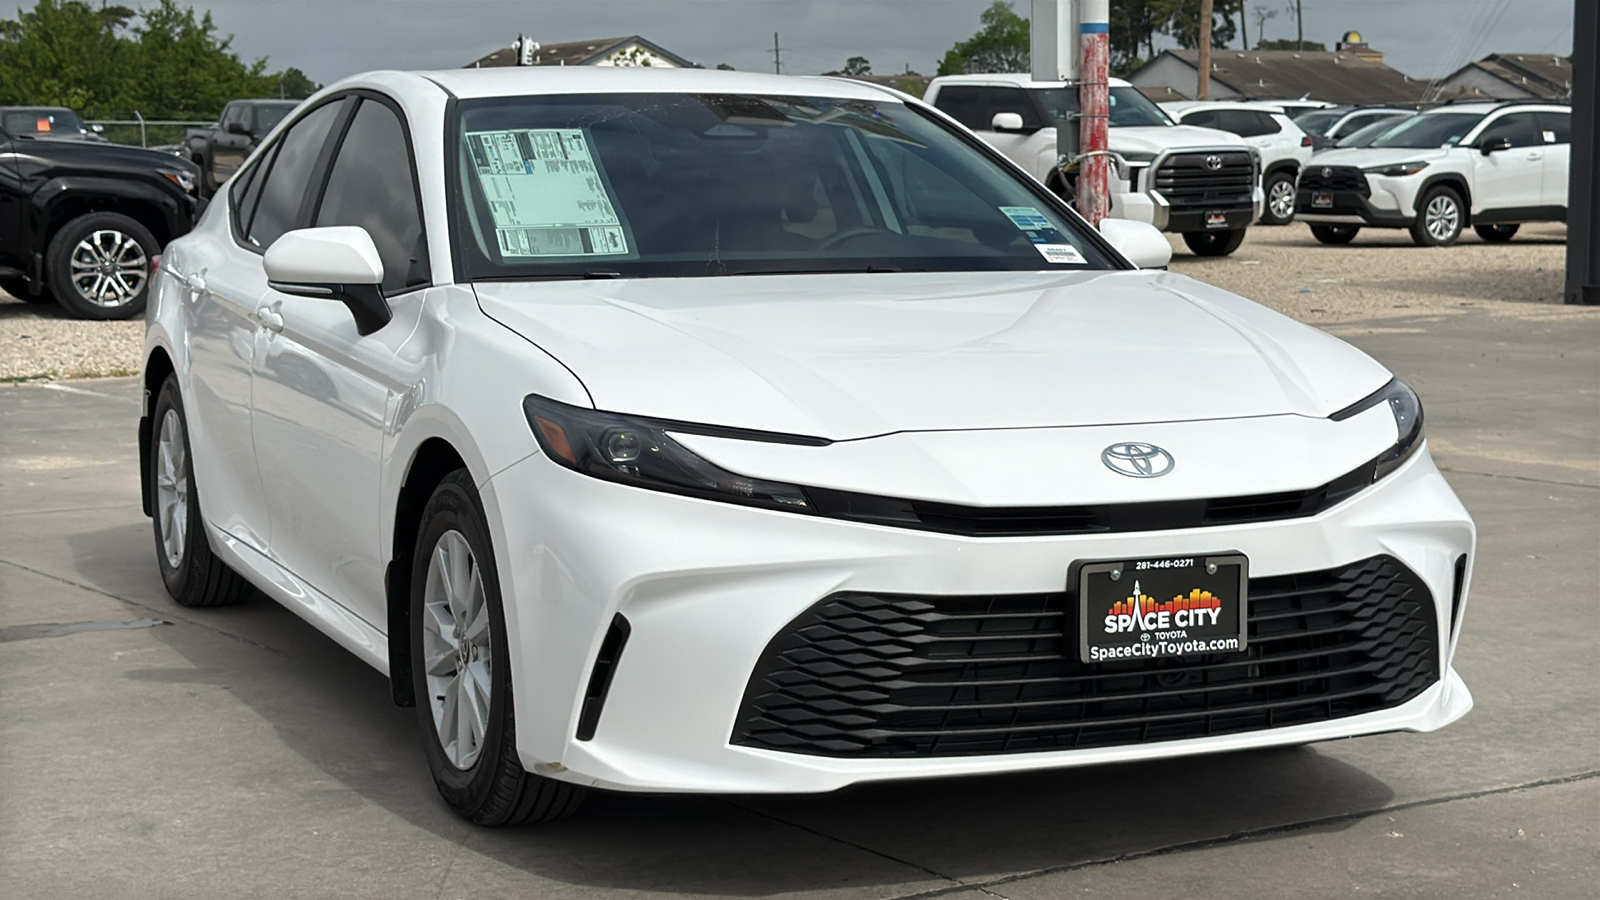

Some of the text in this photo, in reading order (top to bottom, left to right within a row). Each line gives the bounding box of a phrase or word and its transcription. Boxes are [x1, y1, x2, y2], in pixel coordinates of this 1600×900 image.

[1135, 559, 1194, 570] 281-446-0271
[1104, 595, 1222, 633] SPACE CITY
[1154, 630, 1187, 640] TOYOTA
[1090, 638, 1238, 661] SpaceCityToyota.com
